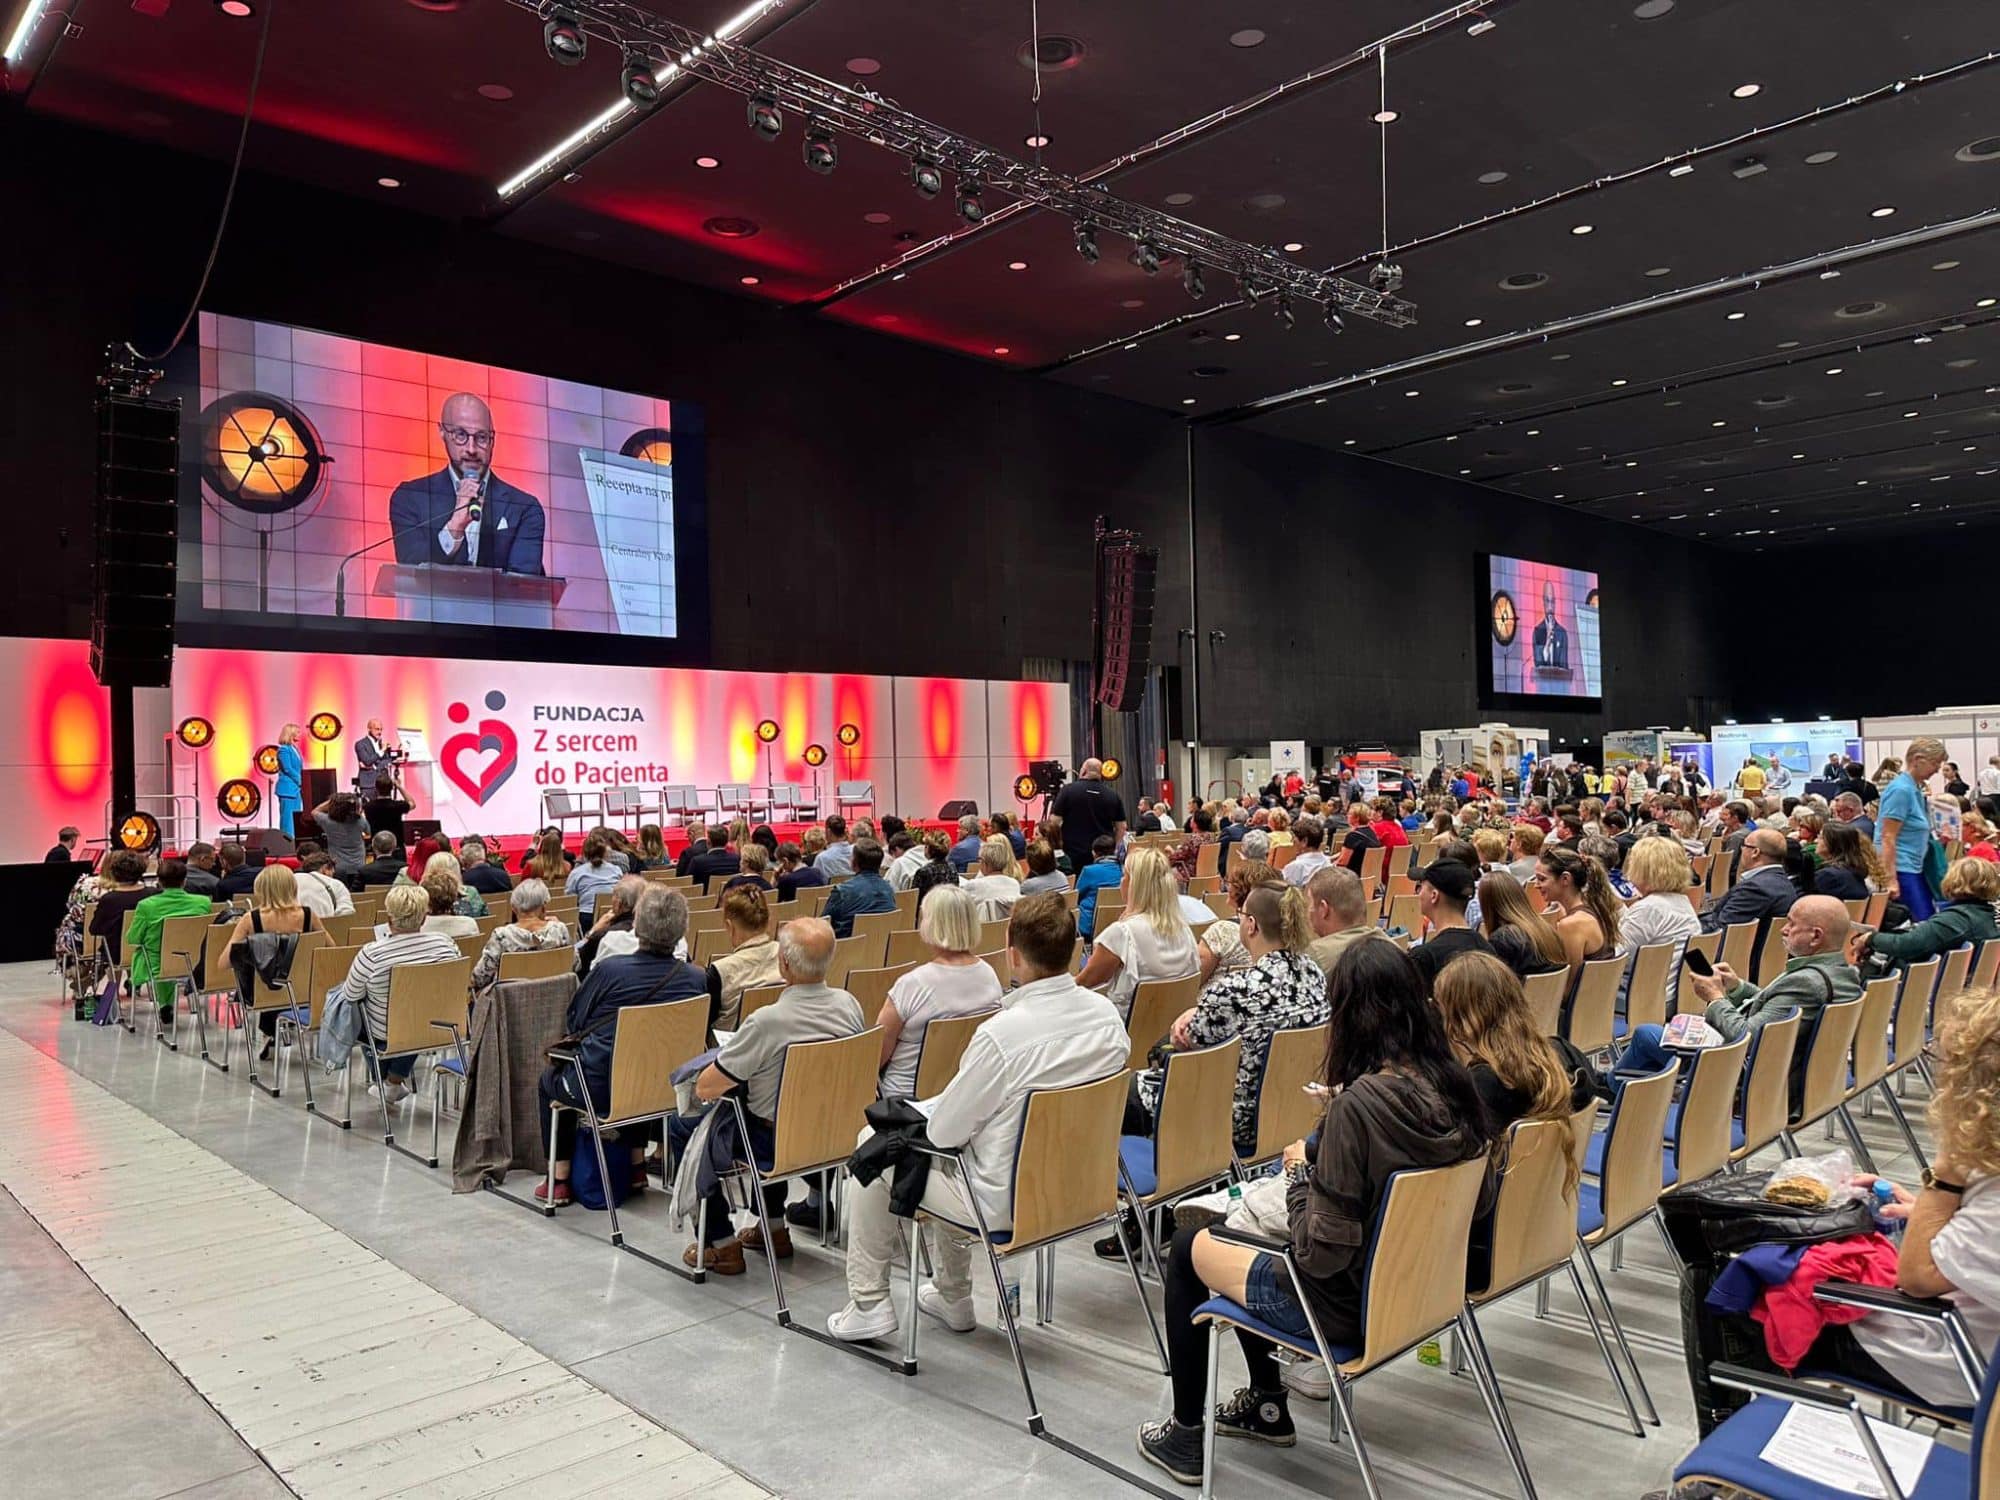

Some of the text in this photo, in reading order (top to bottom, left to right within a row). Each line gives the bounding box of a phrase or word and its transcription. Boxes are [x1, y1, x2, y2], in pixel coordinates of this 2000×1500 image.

[595, 474, 643, 495] Recepta
[645, 486, 659, 498] na
[534, 705, 644, 722] FUNDACJA
[534, 729, 638, 752] Z sercem
[535, 760, 669, 786] do Pacjenta
